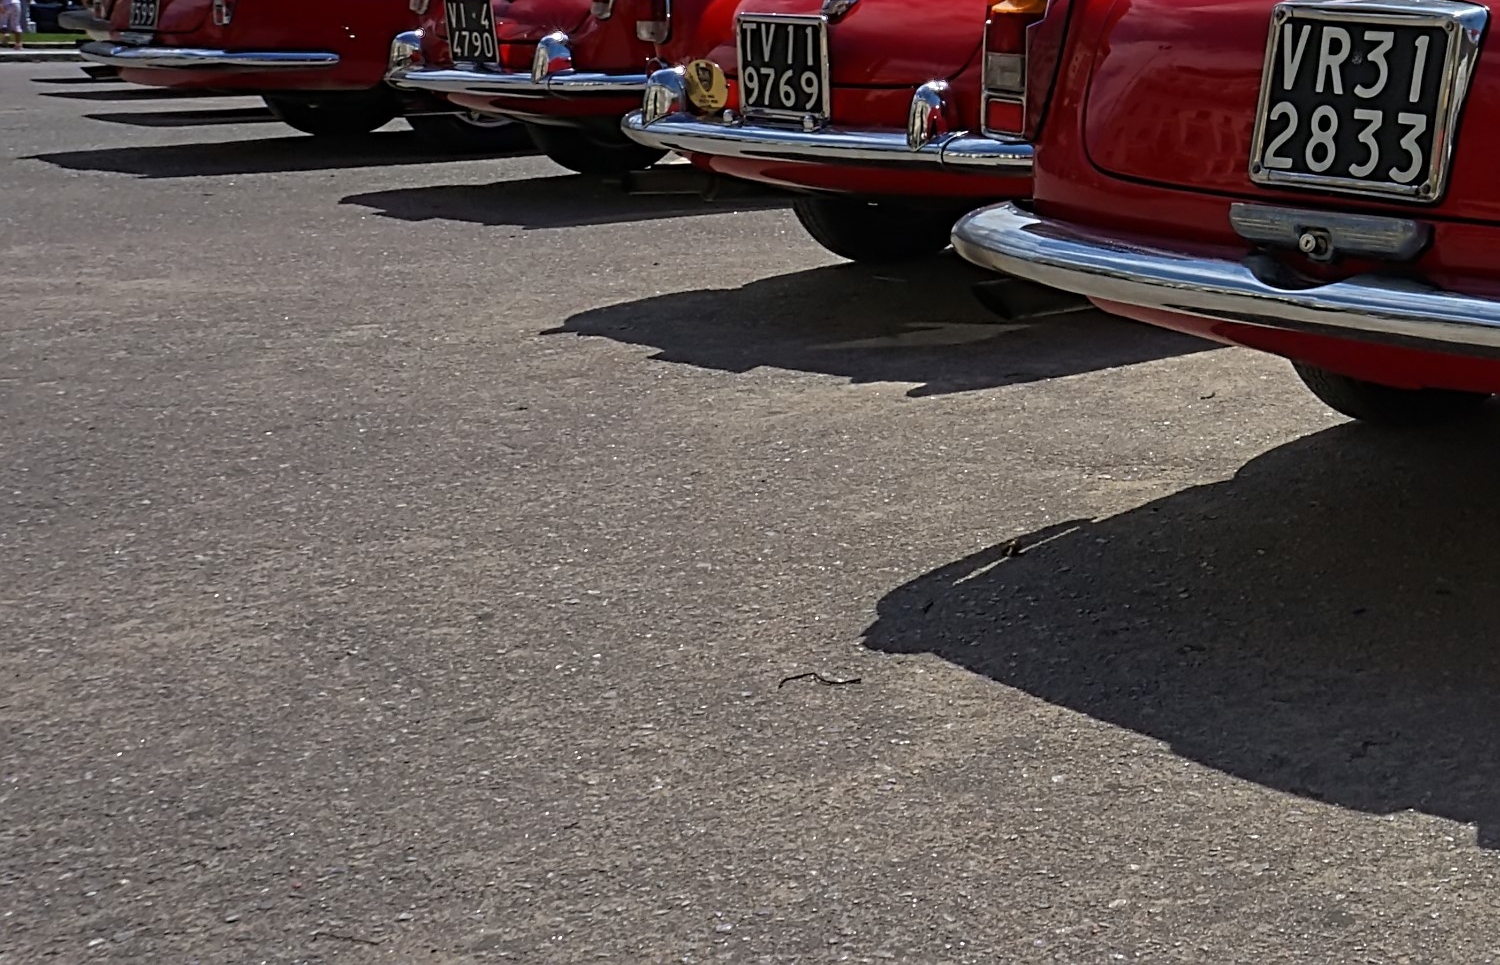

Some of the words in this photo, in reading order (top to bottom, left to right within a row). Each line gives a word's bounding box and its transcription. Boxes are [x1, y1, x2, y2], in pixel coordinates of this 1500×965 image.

[453, 31, 493, 57] 4790
[1282, 23, 1430, 103] VR31
[744, 66, 819, 110] 9769
[1264, 101, 1428, 184] 2833
